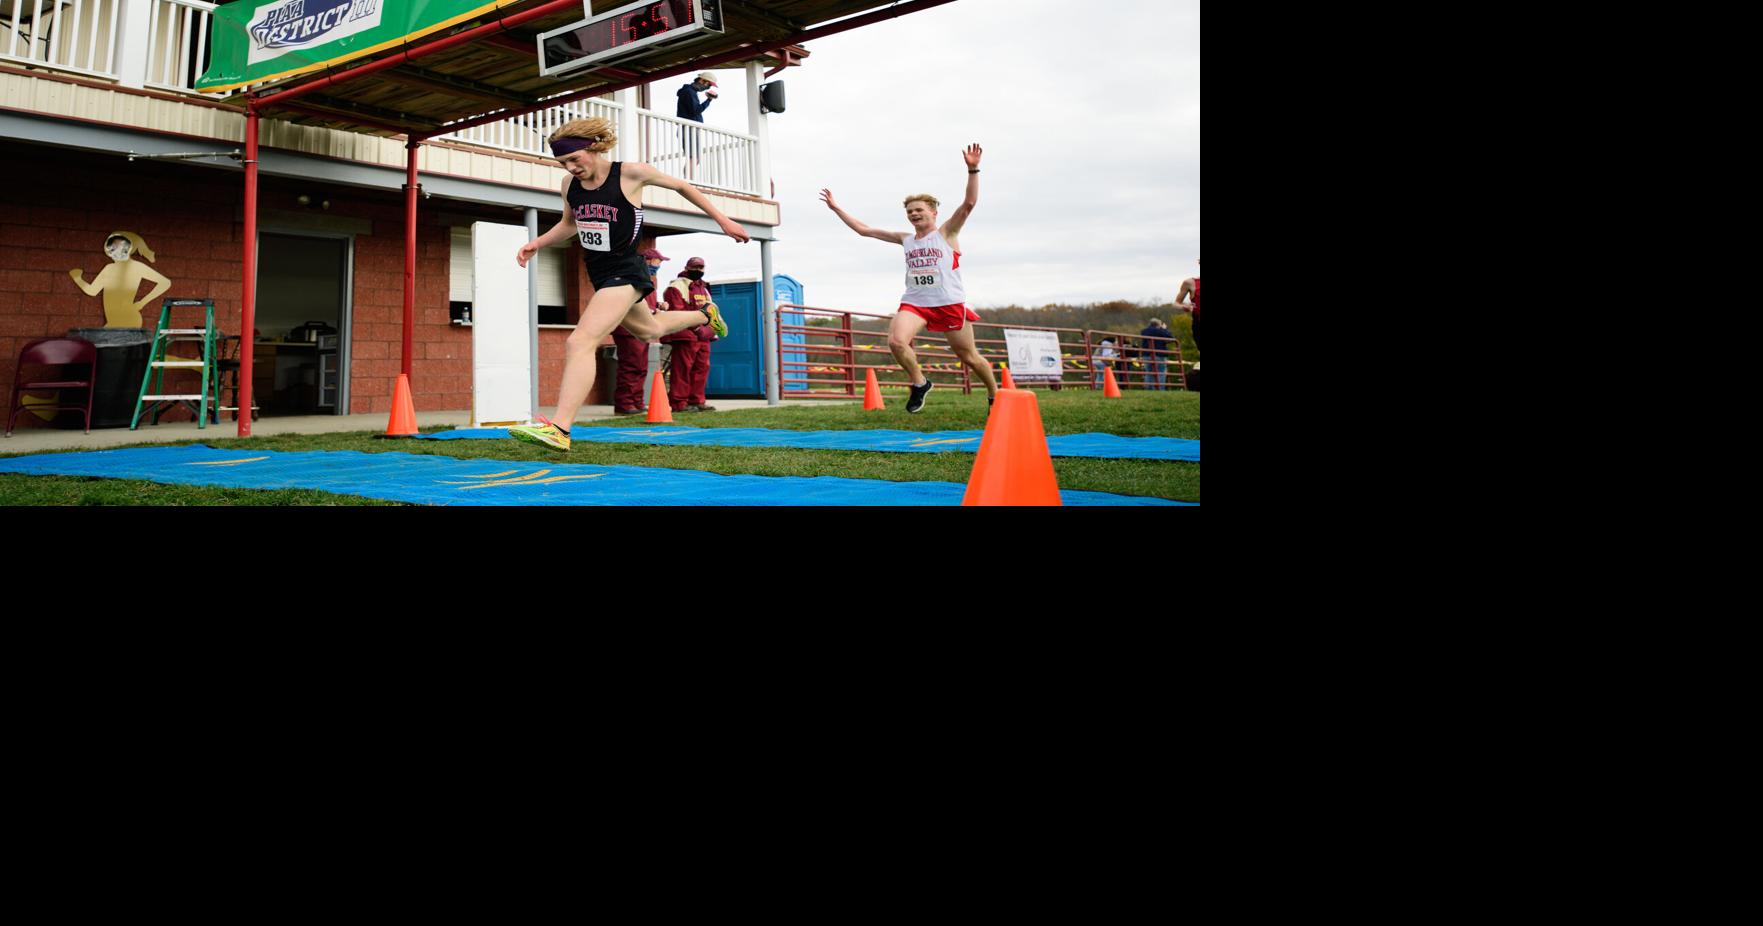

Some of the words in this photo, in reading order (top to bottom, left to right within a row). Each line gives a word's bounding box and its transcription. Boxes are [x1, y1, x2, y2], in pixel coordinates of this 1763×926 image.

[580, 231, 602, 246] 293
[907, 258, 938, 268] VALLEY
[914, 275, 934, 285] 139
